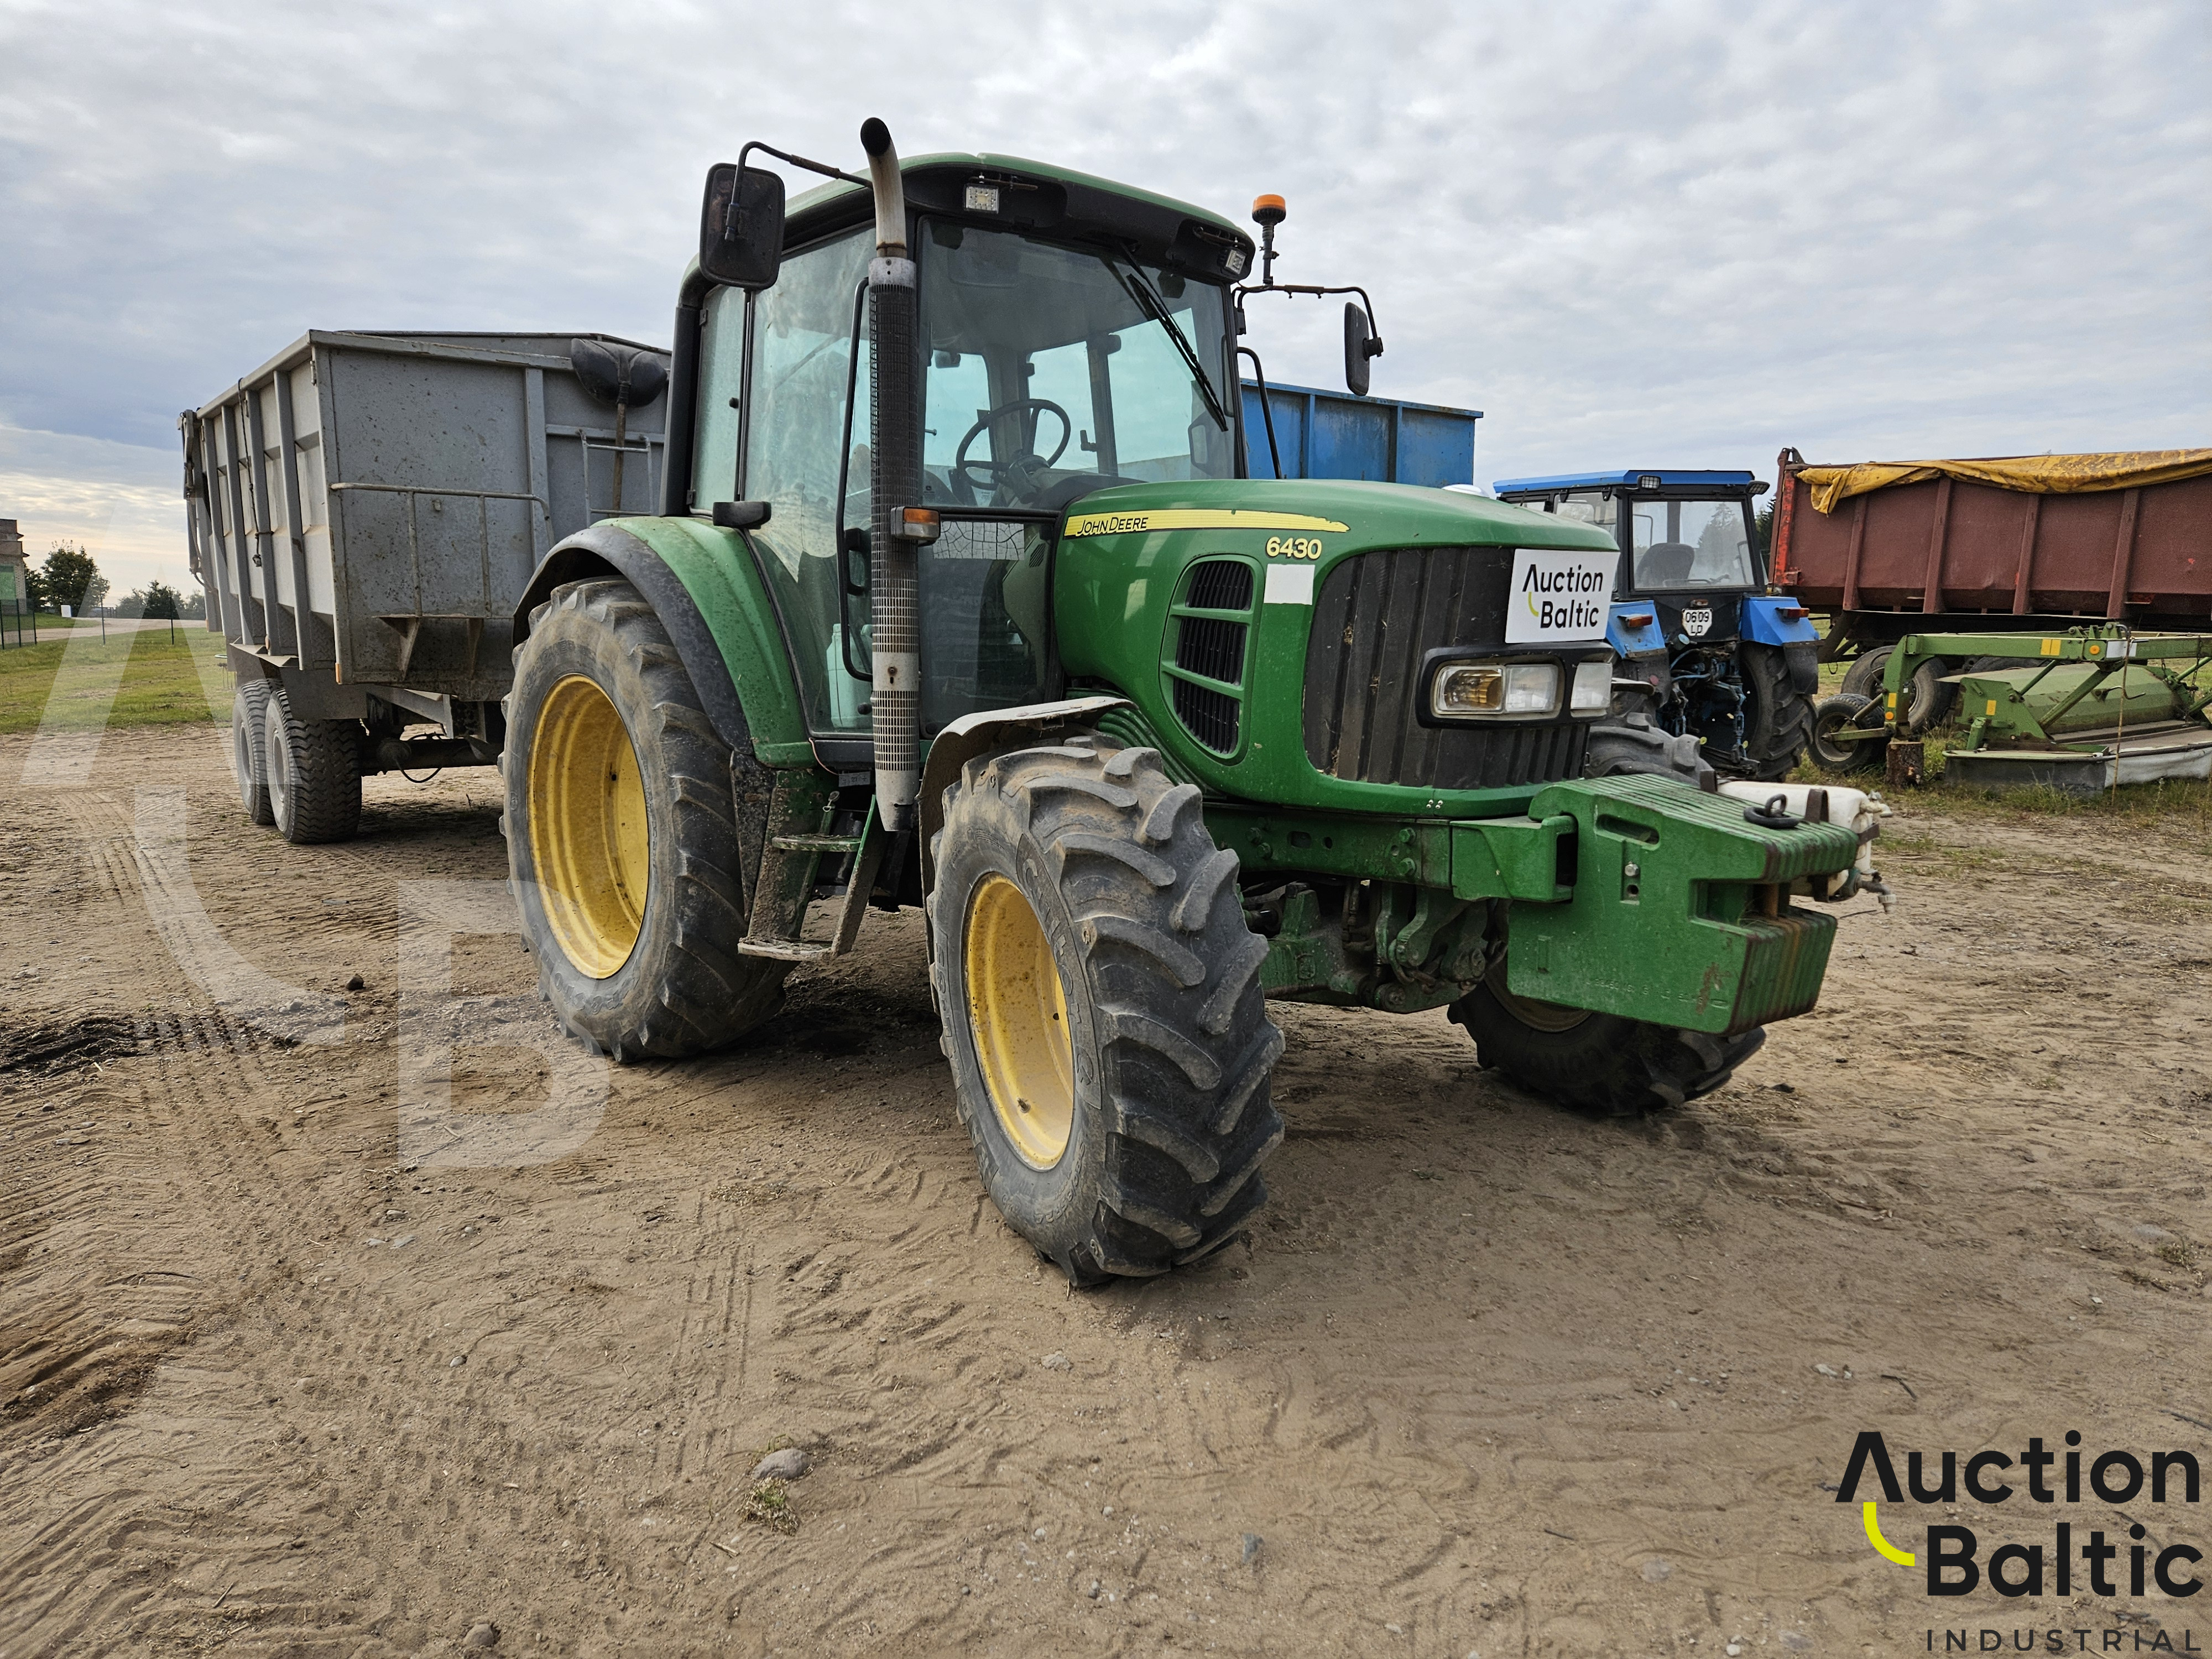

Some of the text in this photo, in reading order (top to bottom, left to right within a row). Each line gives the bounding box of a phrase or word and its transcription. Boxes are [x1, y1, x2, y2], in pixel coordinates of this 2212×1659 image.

[1077, 517, 1149, 535] JOHN DEERE
[1266, 536, 1322, 560] 6430
[1522, 564, 1604, 593] Auction
[1540, 599, 1599, 629] Baltic
[1686, 612, 1709, 623] 0609
[1691, 625, 1703, 634] LD
